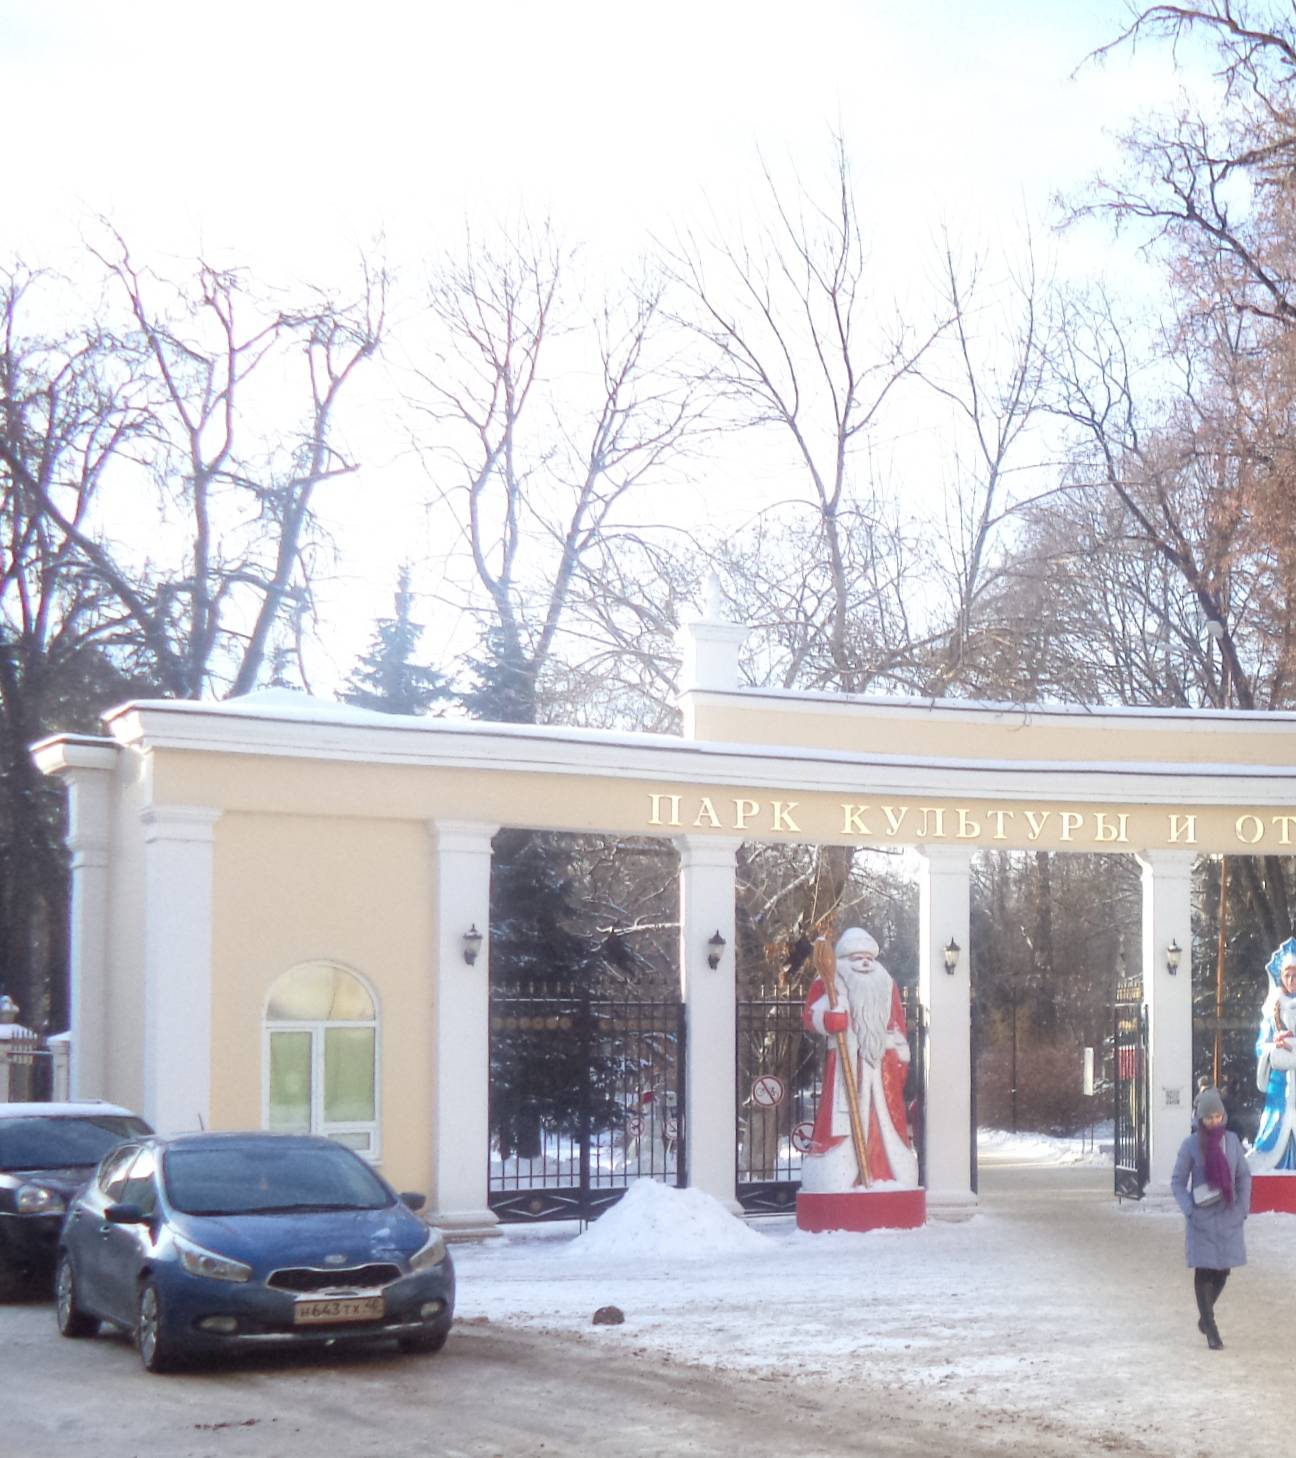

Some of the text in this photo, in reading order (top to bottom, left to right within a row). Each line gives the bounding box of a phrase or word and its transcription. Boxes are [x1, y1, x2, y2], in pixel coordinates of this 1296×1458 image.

[647, 793, 801, 832] ПАРК
[840, 804, 1129, 842] КУЛЬТУРЫ
[1167, 815, 1197, 843] И
